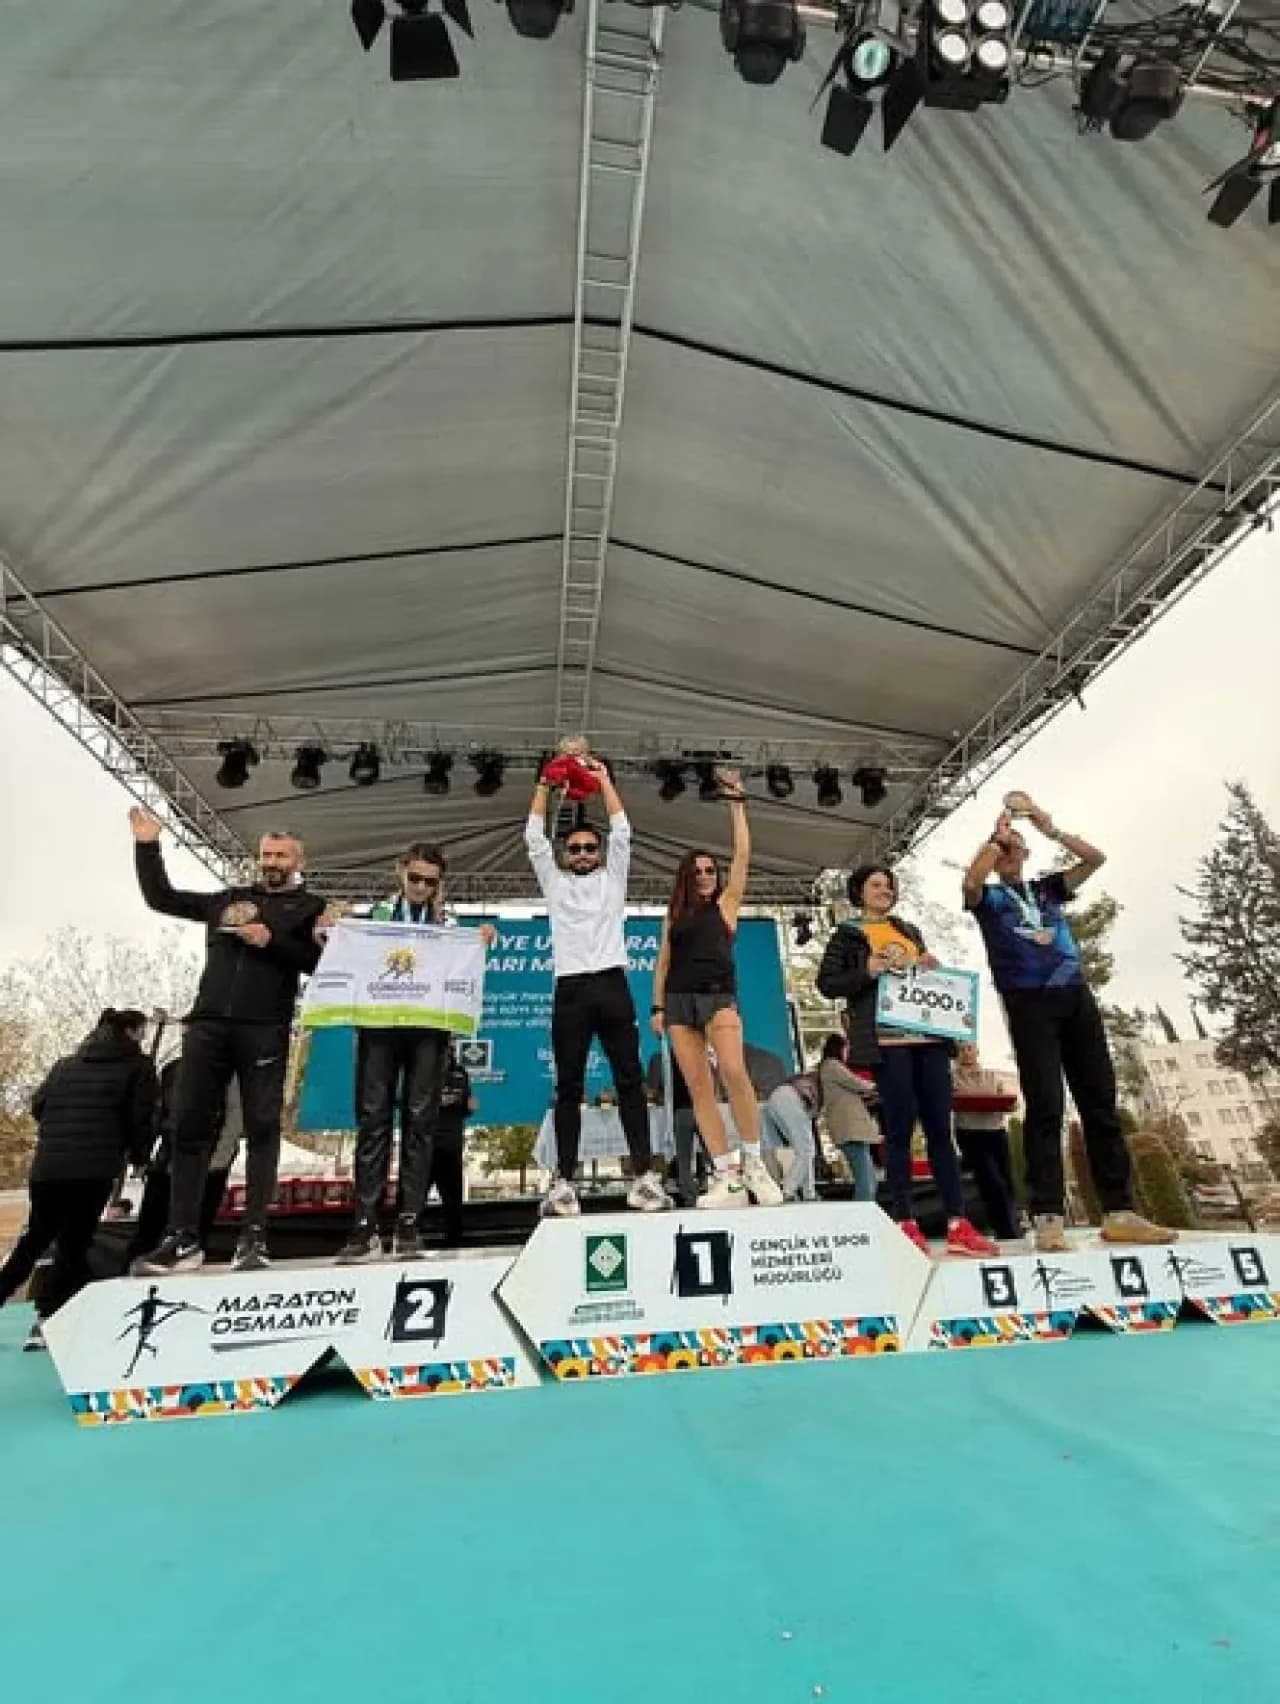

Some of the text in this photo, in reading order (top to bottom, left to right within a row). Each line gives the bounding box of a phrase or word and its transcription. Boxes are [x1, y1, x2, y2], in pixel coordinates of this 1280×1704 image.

[626, 935, 658, 950] RA
[750, 1232, 871, 1253] GENÇLİK VE SPOR
[690, 1241, 714, 1287] 1
[750, 1250, 833, 1269] HİZMETLERİ
[1240, 1253, 1259, 1281] 5
[753, 1265, 843, 1287] MÜDÜRLÜĞÜ
[987, 1271, 1009, 1301] 3
[1120, 1261, 1141, 1290] 4
[216, 1287, 357, 1314] MARATON
[403, 1287, 435, 1331] 2
[210, 1307, 361, 1336] OSMANİYE
